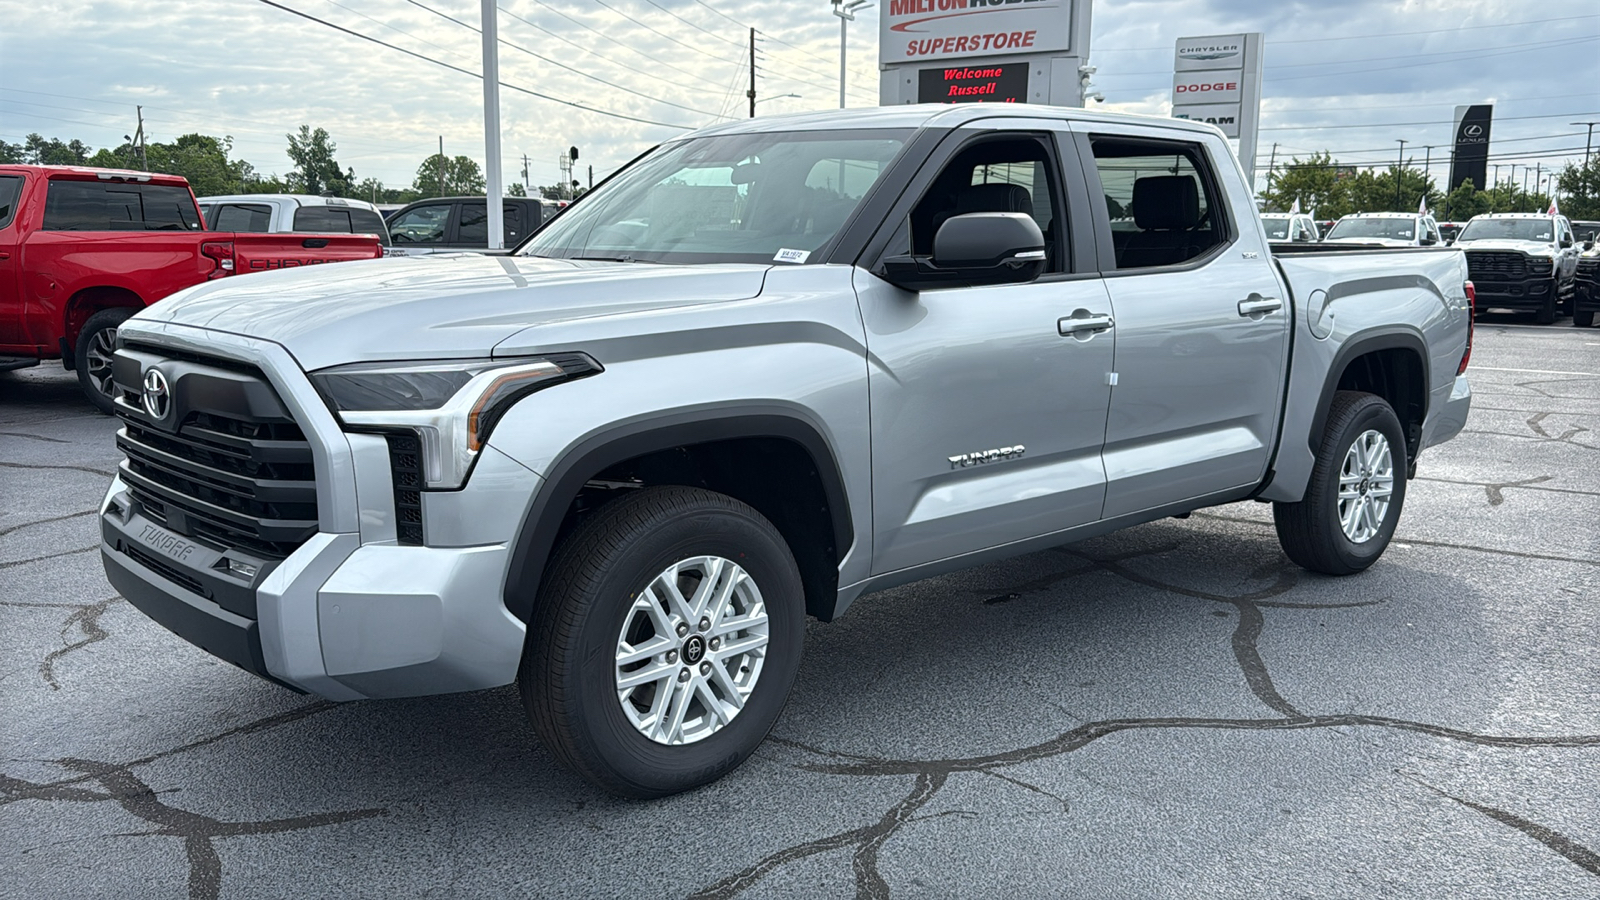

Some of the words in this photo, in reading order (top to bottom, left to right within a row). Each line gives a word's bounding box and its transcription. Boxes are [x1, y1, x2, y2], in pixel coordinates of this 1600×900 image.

[906, 30, 1037, 56] SUPERSTORE
[1180, 46, 1238, 54] CHRYSLER
[944, 68, 1003, 80] Welcome
[947, 82, 997, 97] Russell
[1176, 82, 1237, 93] DODGE
[948, 445, 1026, 470] TUNDRA
[138, 524, 197, 561] TUNDRA
